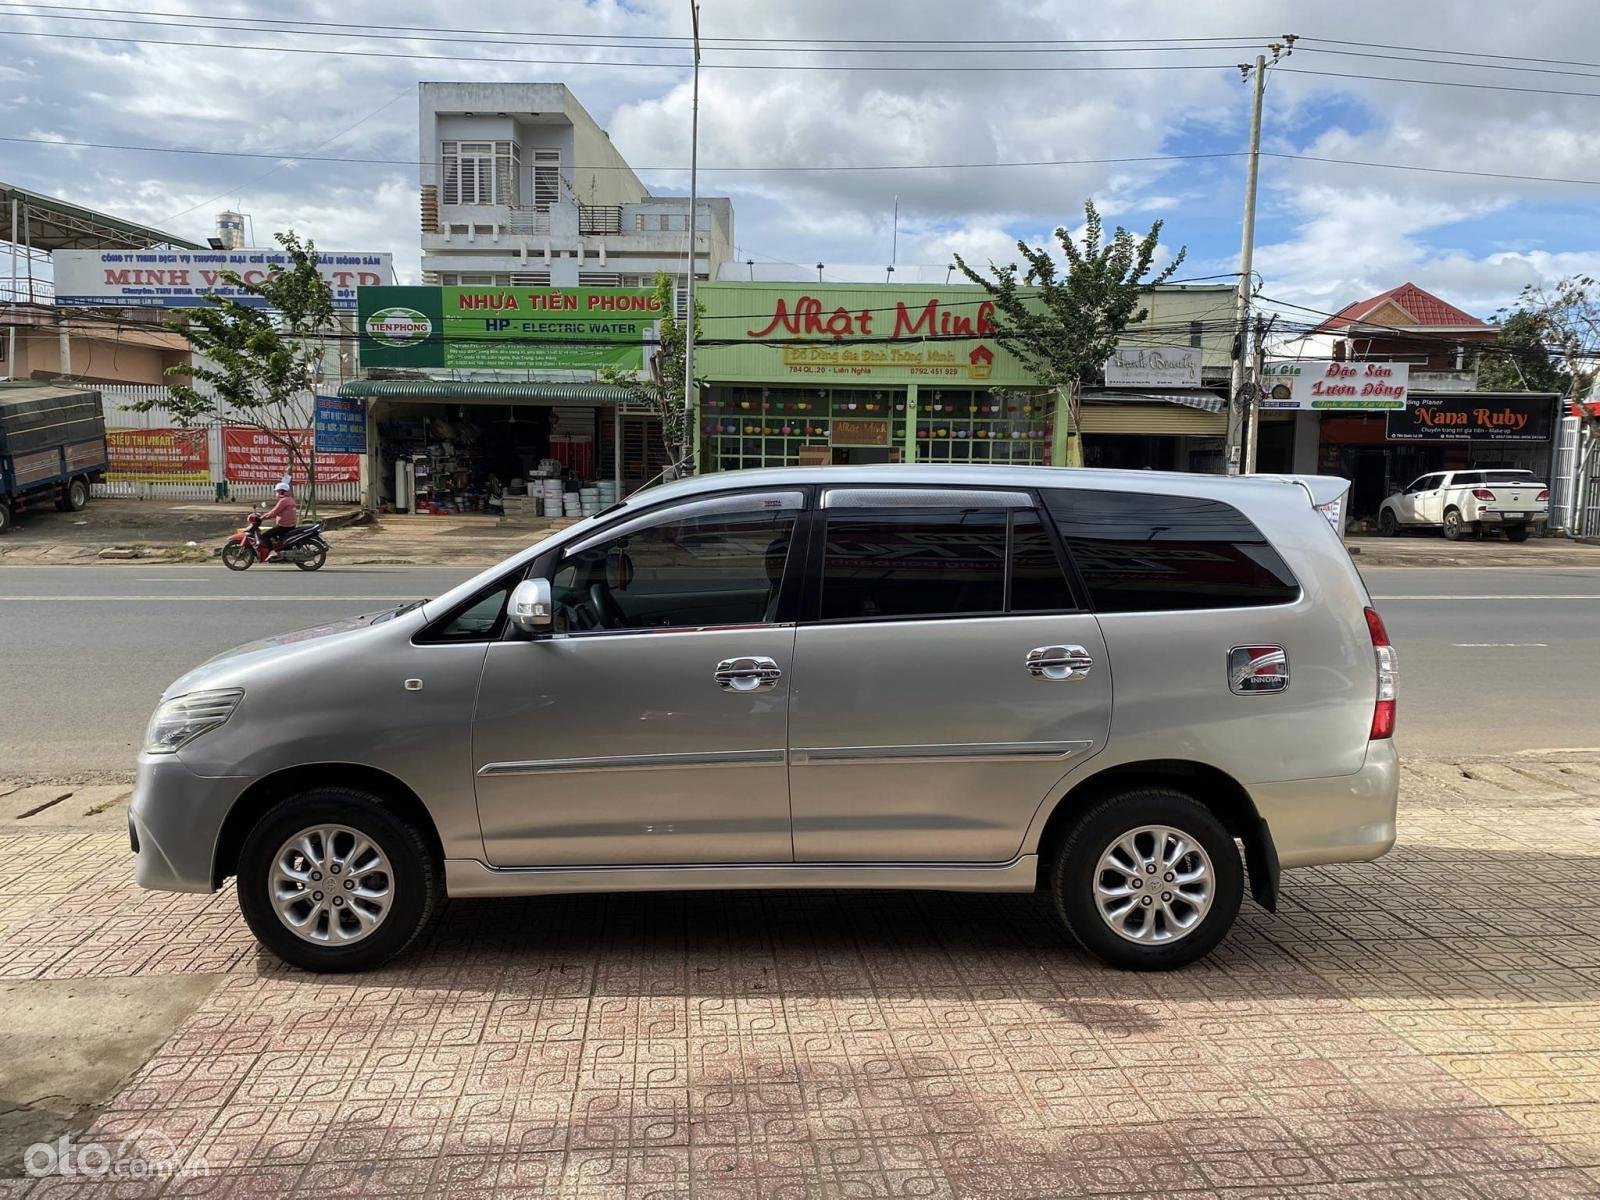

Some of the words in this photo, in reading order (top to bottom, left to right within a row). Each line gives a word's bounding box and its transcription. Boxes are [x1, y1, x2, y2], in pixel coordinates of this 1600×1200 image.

[104, 269, 190, 285] MINH
[459, 292, 519, 315] NHỰA
[528, 290, 579, 310] TIỀN
[588, 295, 661, 312] PHONG
[485, 319, 511, 331] HP
[522, 322, 585, 333] ELECTRIC
[590, 323, 636, 334] WATER
[747, 296, 873, 340] Nhật
[893, 299, 996, 339] Minh
[1414, 407, 1468, 426] Nana
[1473, 408, 1528, 429] Ruby
